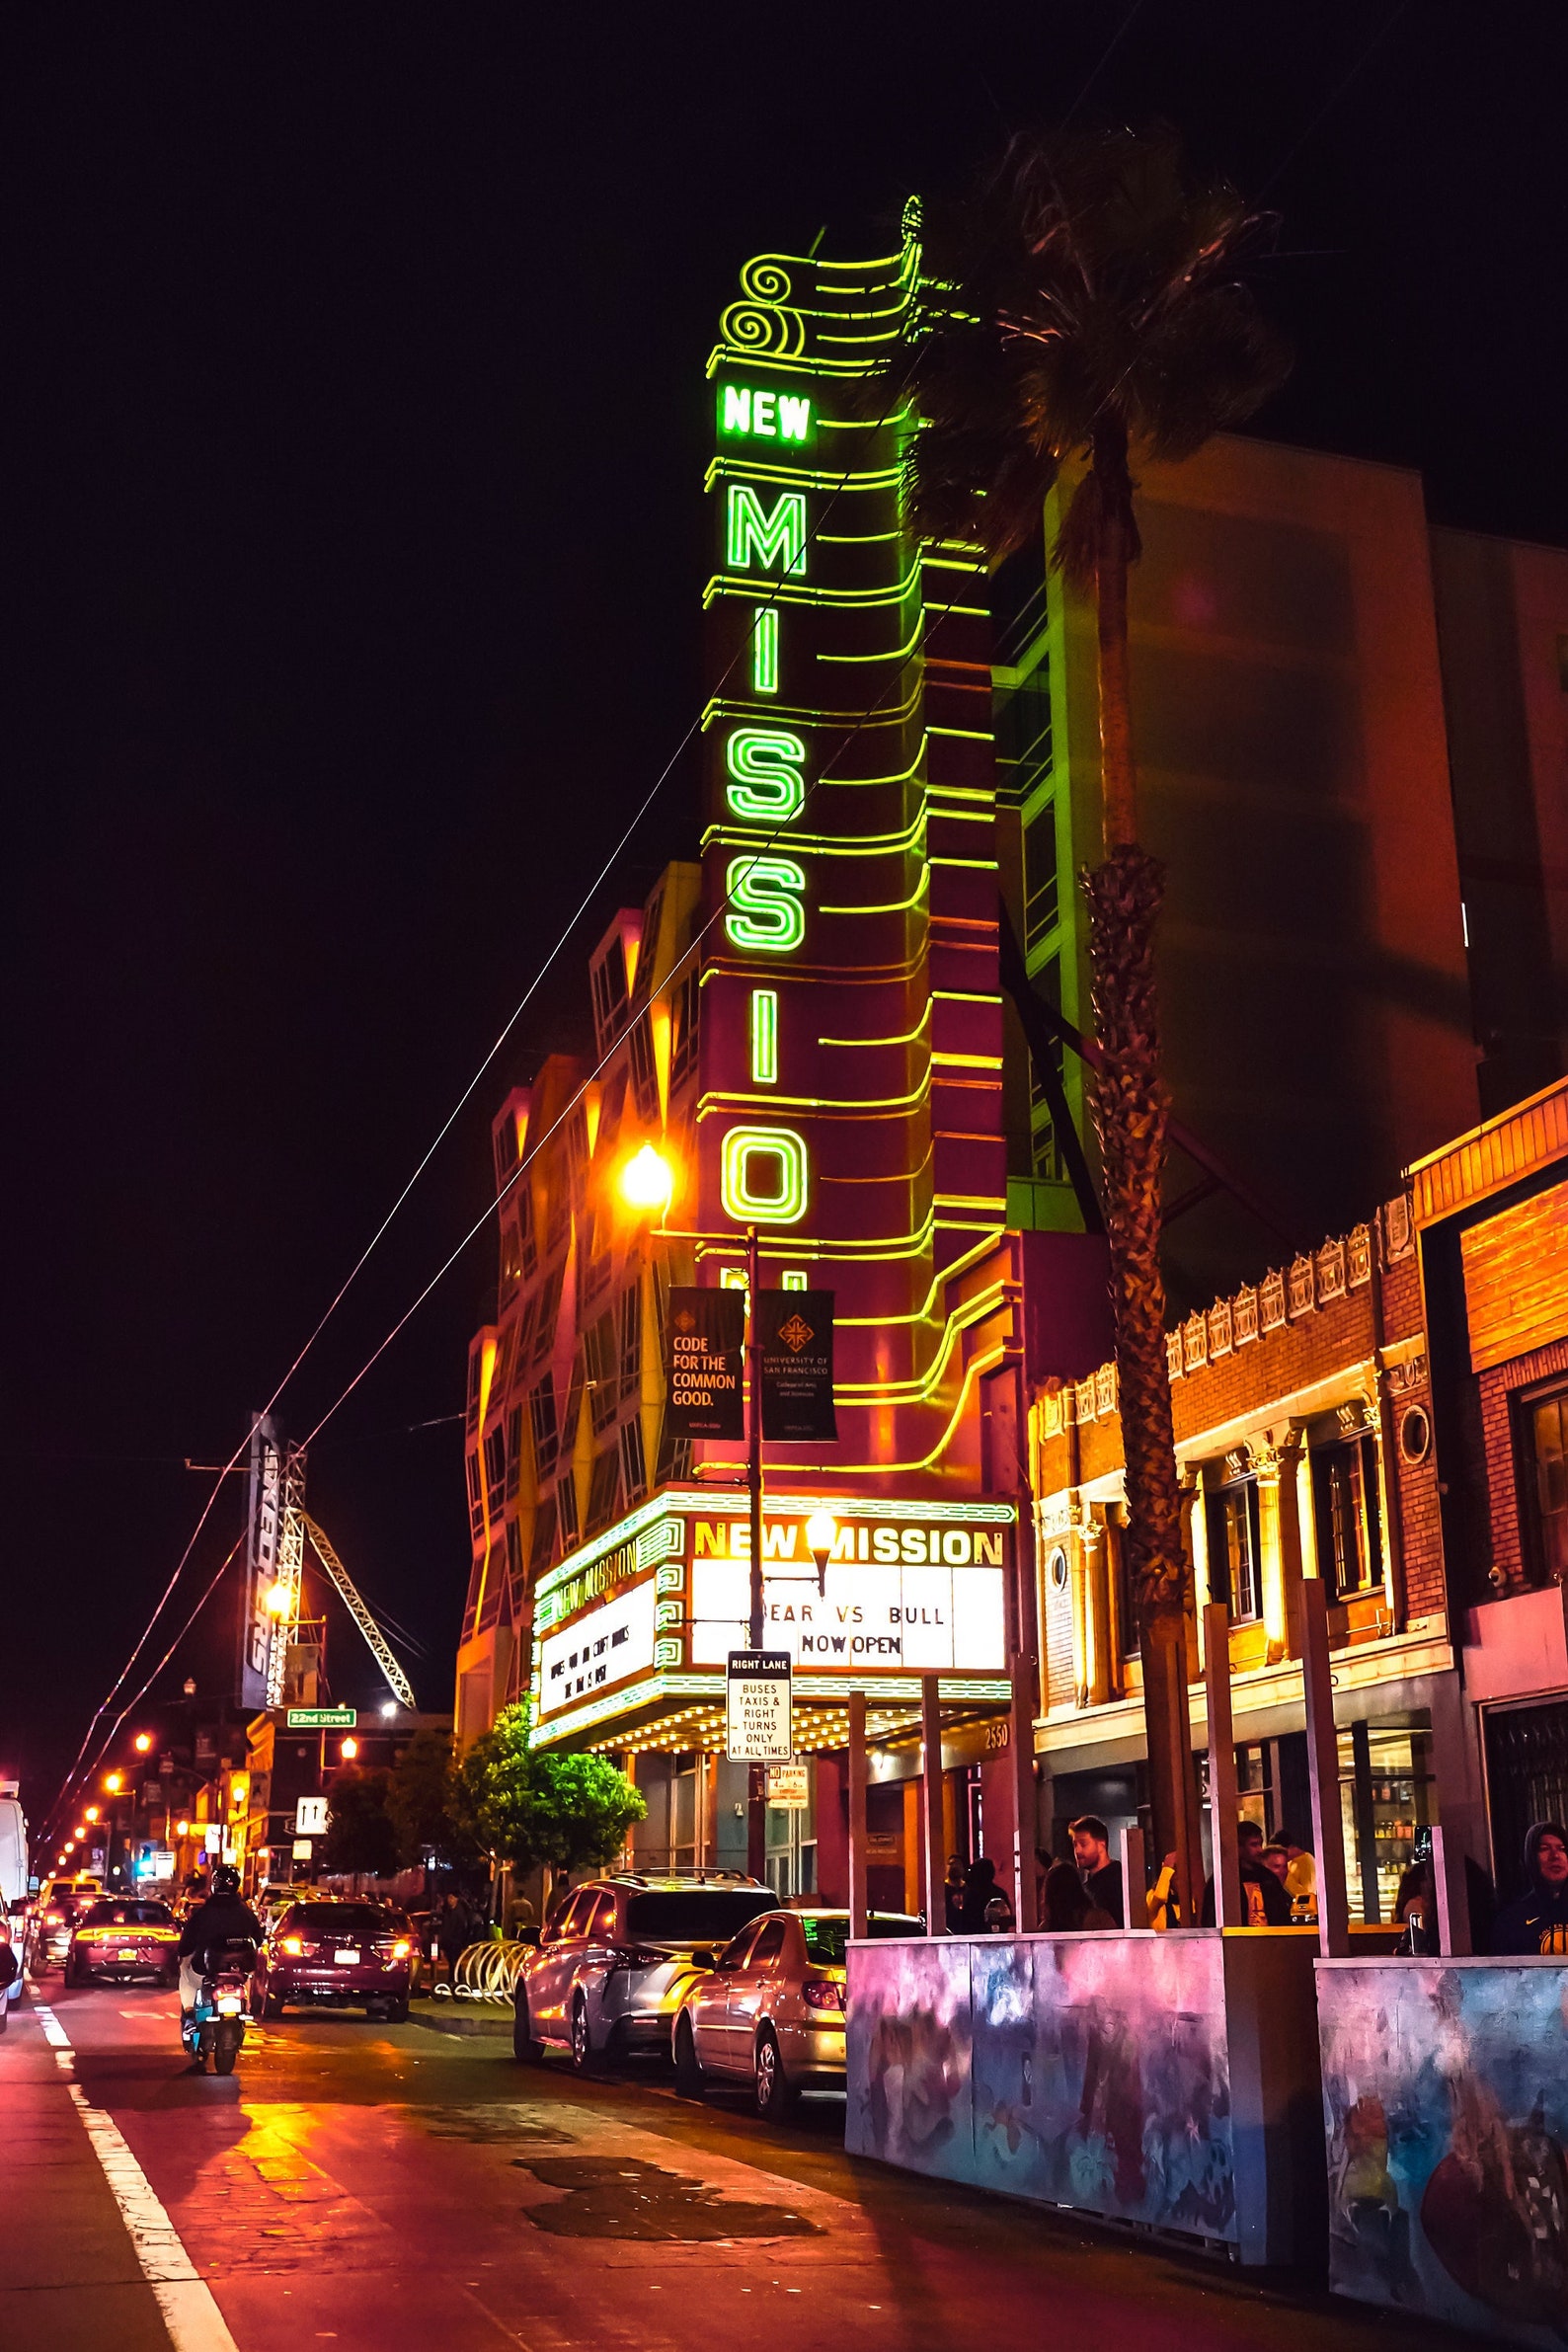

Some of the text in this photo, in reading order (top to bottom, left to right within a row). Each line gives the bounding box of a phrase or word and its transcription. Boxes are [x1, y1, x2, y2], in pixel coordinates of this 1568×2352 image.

[724, 385, 811, 441] NEW
[721, 484, 808, 1291] MISSIO
[673, 1336, 708, 1352] CODE
[673, 1355, 726, 1371] FOR THE
[672, 1372, 736, 1389] COMMON
[672, 1390, 714, 1406] GOOD.
[694, 1522, 798, 1558] NEW
[585, 1539, 637, 1602] MISSION
[763, 1604, 944, 1625] EAR VS BULL
[802, 1634, 902, 1654] NOW OPEN
[732, 1660, 788, 1670] RIGHT LANE
[743, 1685, 777, 1693] BUSES
[740, 1696, 780, 1706] TAXIS &
[290, 1713, 351, 1723] 22nd Street
[745, 1709, 775, 1718] RIGHT
[743, 1721, 777, 1731] TURNS
[745, 1734, 773, 1743] ONLY
[985, 1723, 1008, 1750] 2550
[732, 1746, 788, 1756] AT ALL TIMES
[769, 1766, 780, 1778] NO
